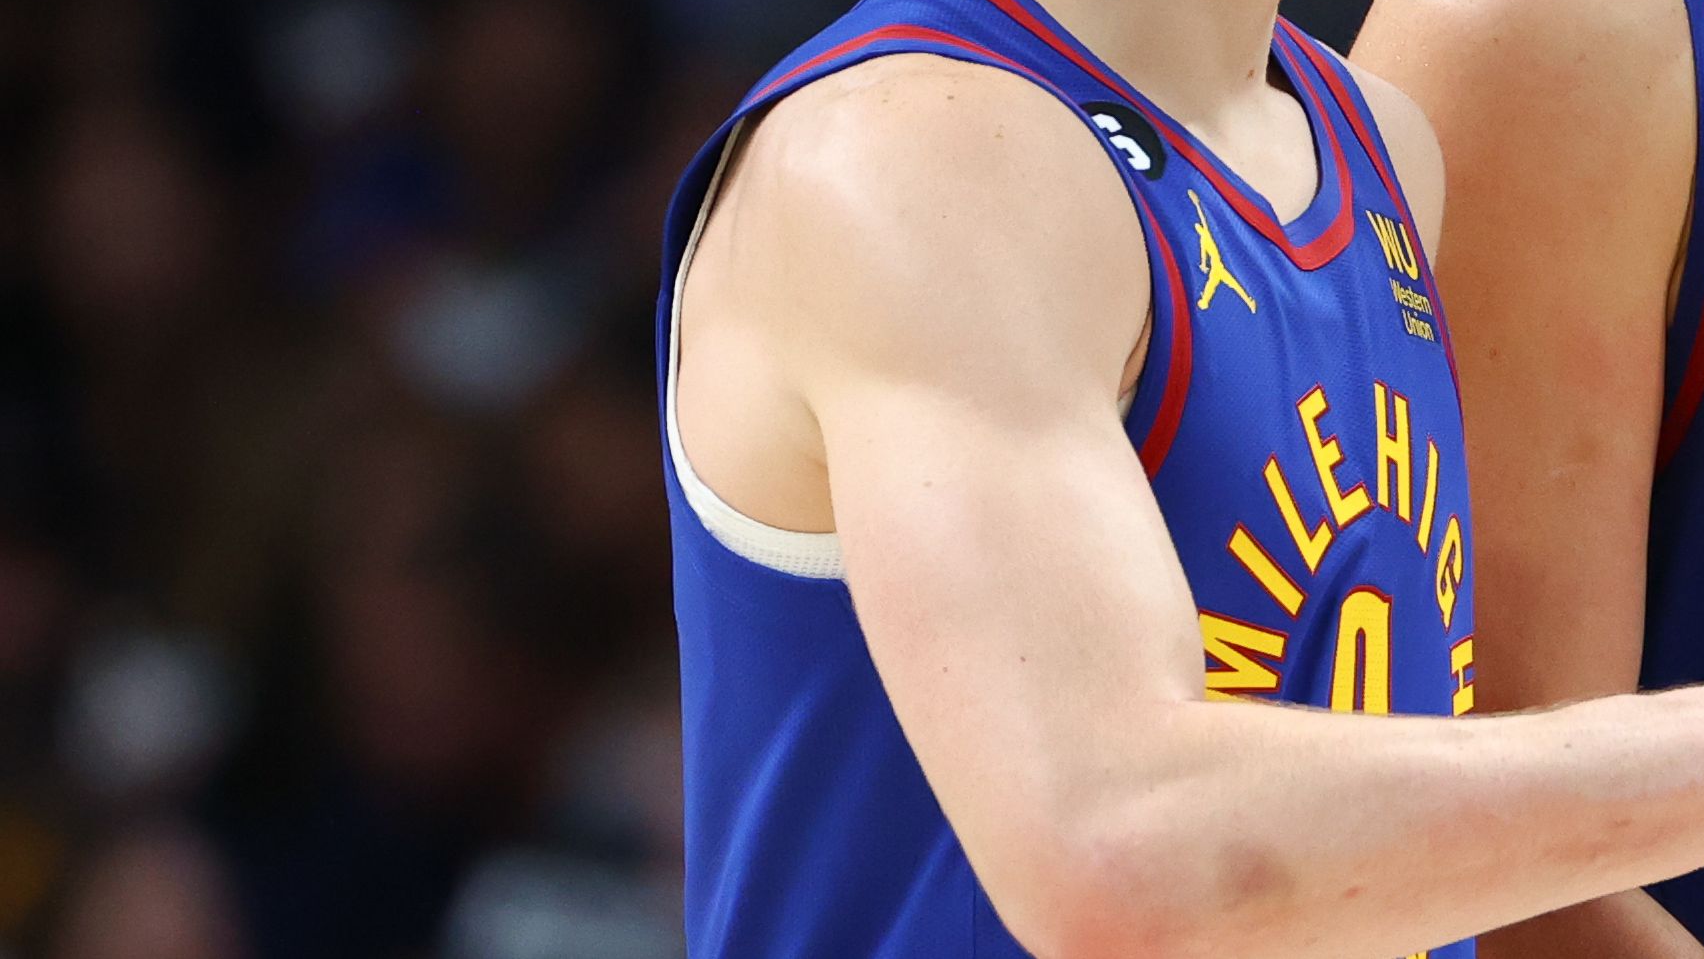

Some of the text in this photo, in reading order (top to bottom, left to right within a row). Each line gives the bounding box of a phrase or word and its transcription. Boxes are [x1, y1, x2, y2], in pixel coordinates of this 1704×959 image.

[1365, 209, 1419, 281] WU
[1388, 277, 1433, 316] Western
[1402, 308, 1435, 342] Union
[1198, 378, 1475, 717] MILE HIGH
